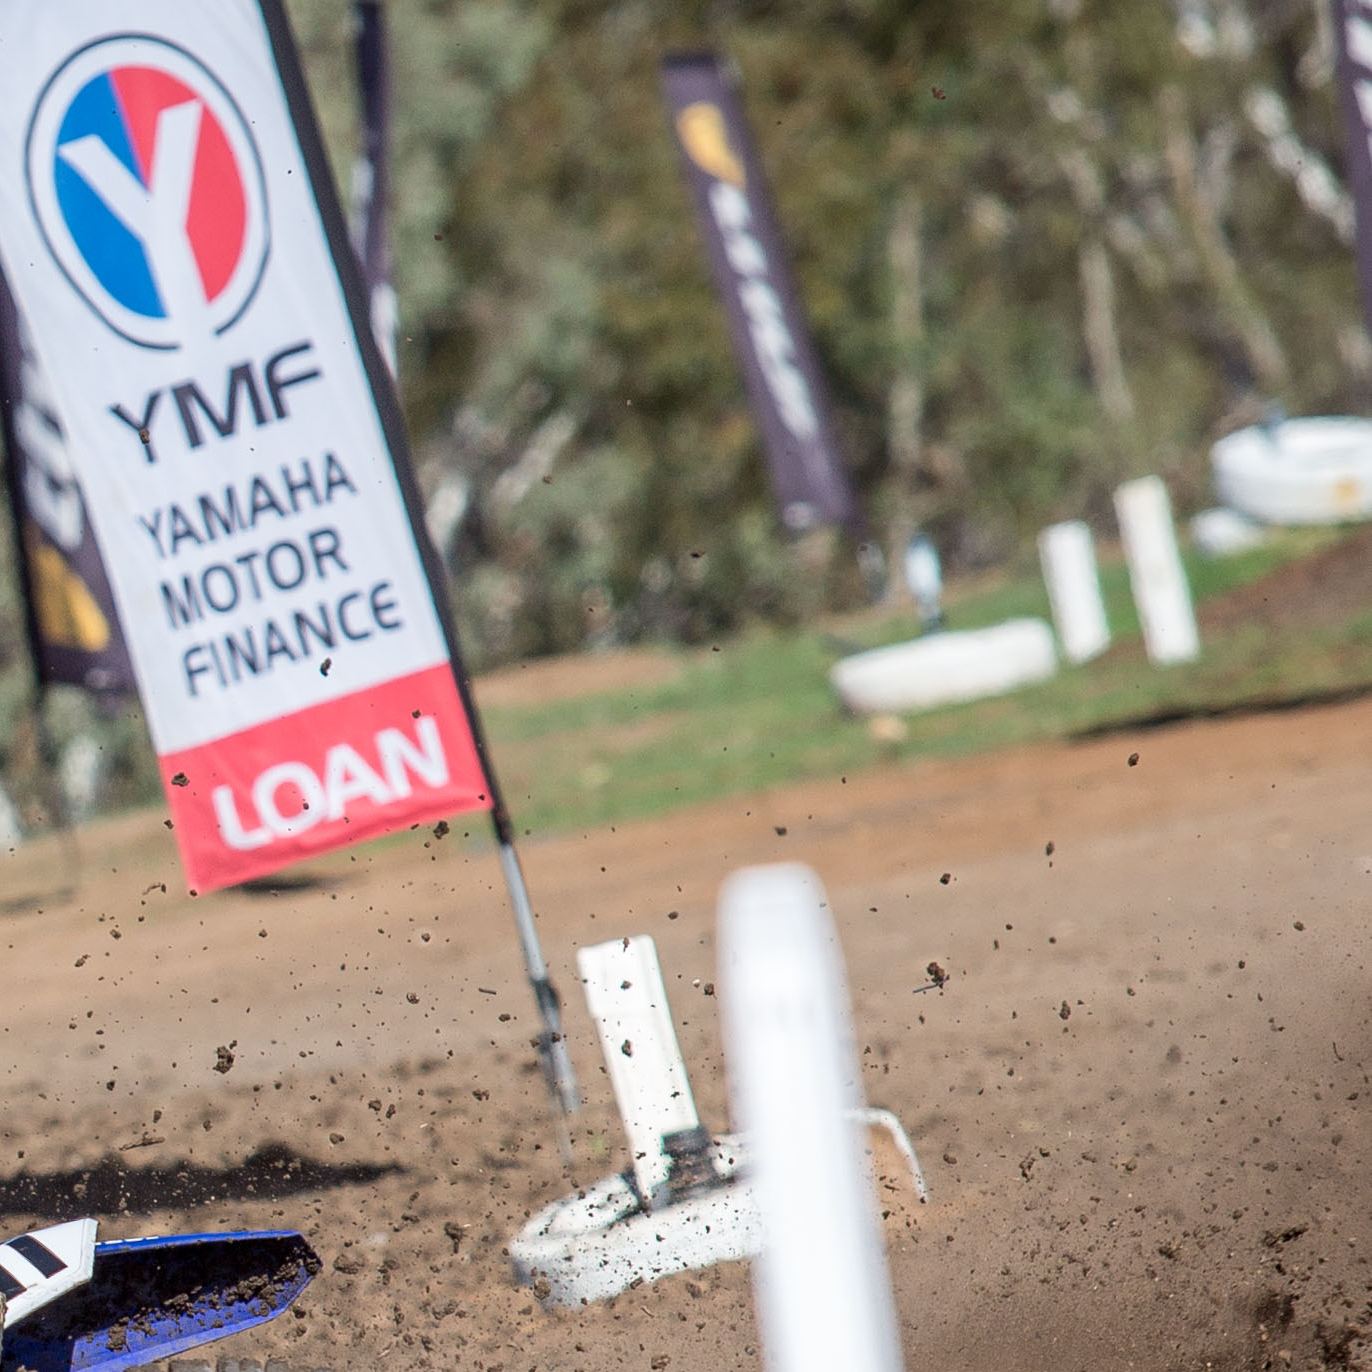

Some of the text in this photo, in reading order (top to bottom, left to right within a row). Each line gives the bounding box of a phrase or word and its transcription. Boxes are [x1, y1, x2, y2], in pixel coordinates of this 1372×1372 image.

[110, 339, 322, 465] YMF
[137, 452, 357, 560] YAMAHA
[160, 527, 349, 632] MOTOR
[182, 581, 404, 698] FINANCE
[213, 714, 451, 851] LOAN
